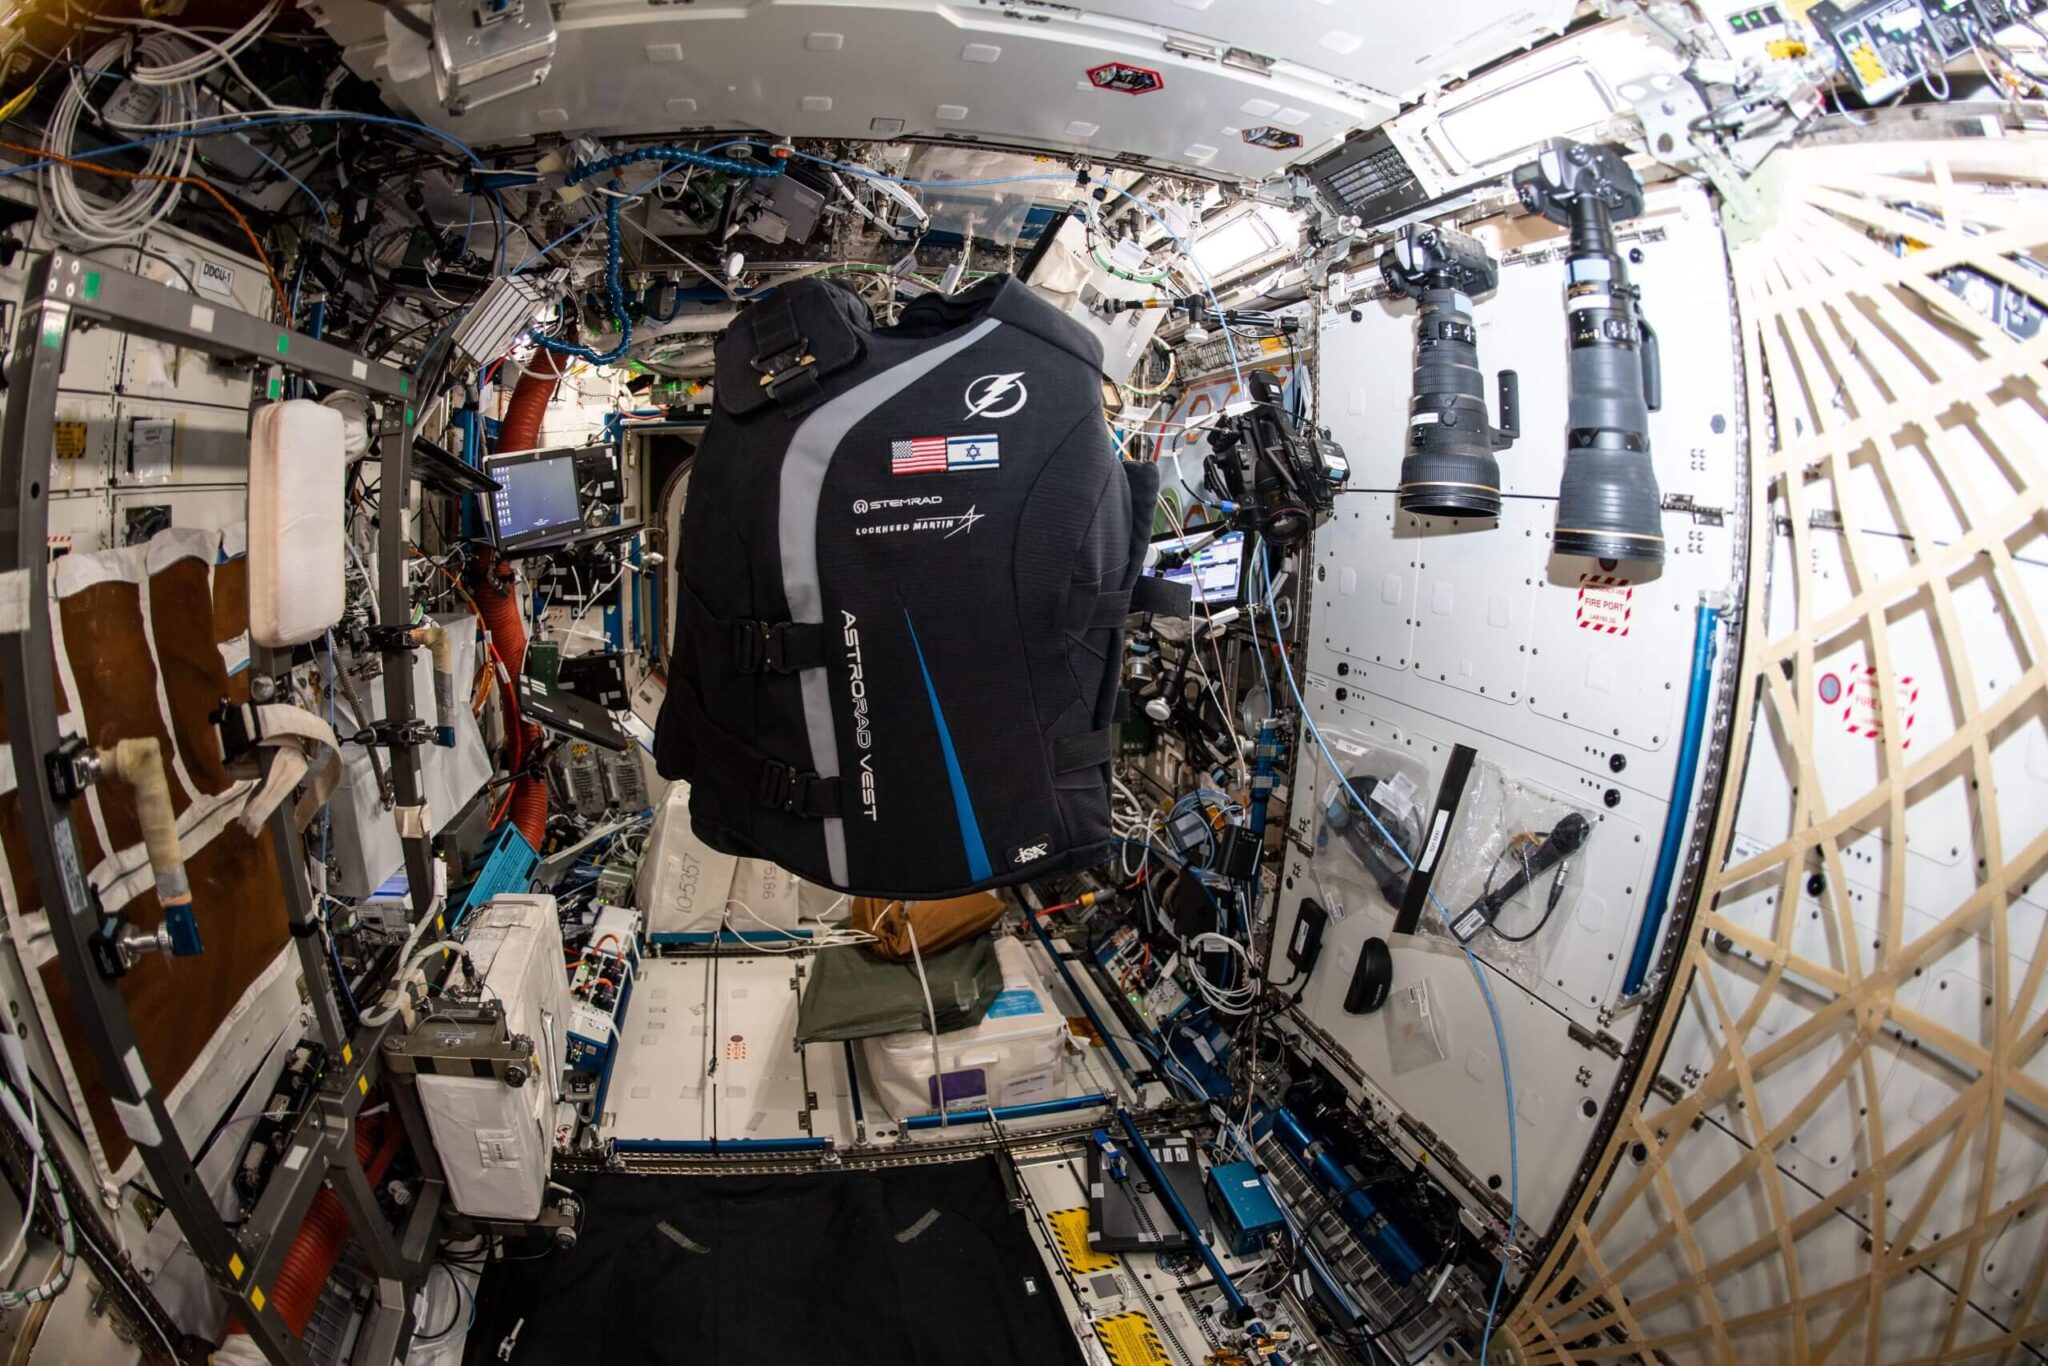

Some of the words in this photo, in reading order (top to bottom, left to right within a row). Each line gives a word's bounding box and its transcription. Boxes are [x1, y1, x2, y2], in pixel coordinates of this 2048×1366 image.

[203, 263, 231, 283] DDCU-1
[870, 496, 943, 510] STEMRAD
[855, 524, 910, 536] LOCKHEED
[912, 520, 954, 532] MARTIN
[1585, 597, 1602, 608] FIRE
[1603, 601, 1623, 611] PORT
[841, 609, 872, 749] ASTRORAD
[859, 753, 877, 822] VEST
